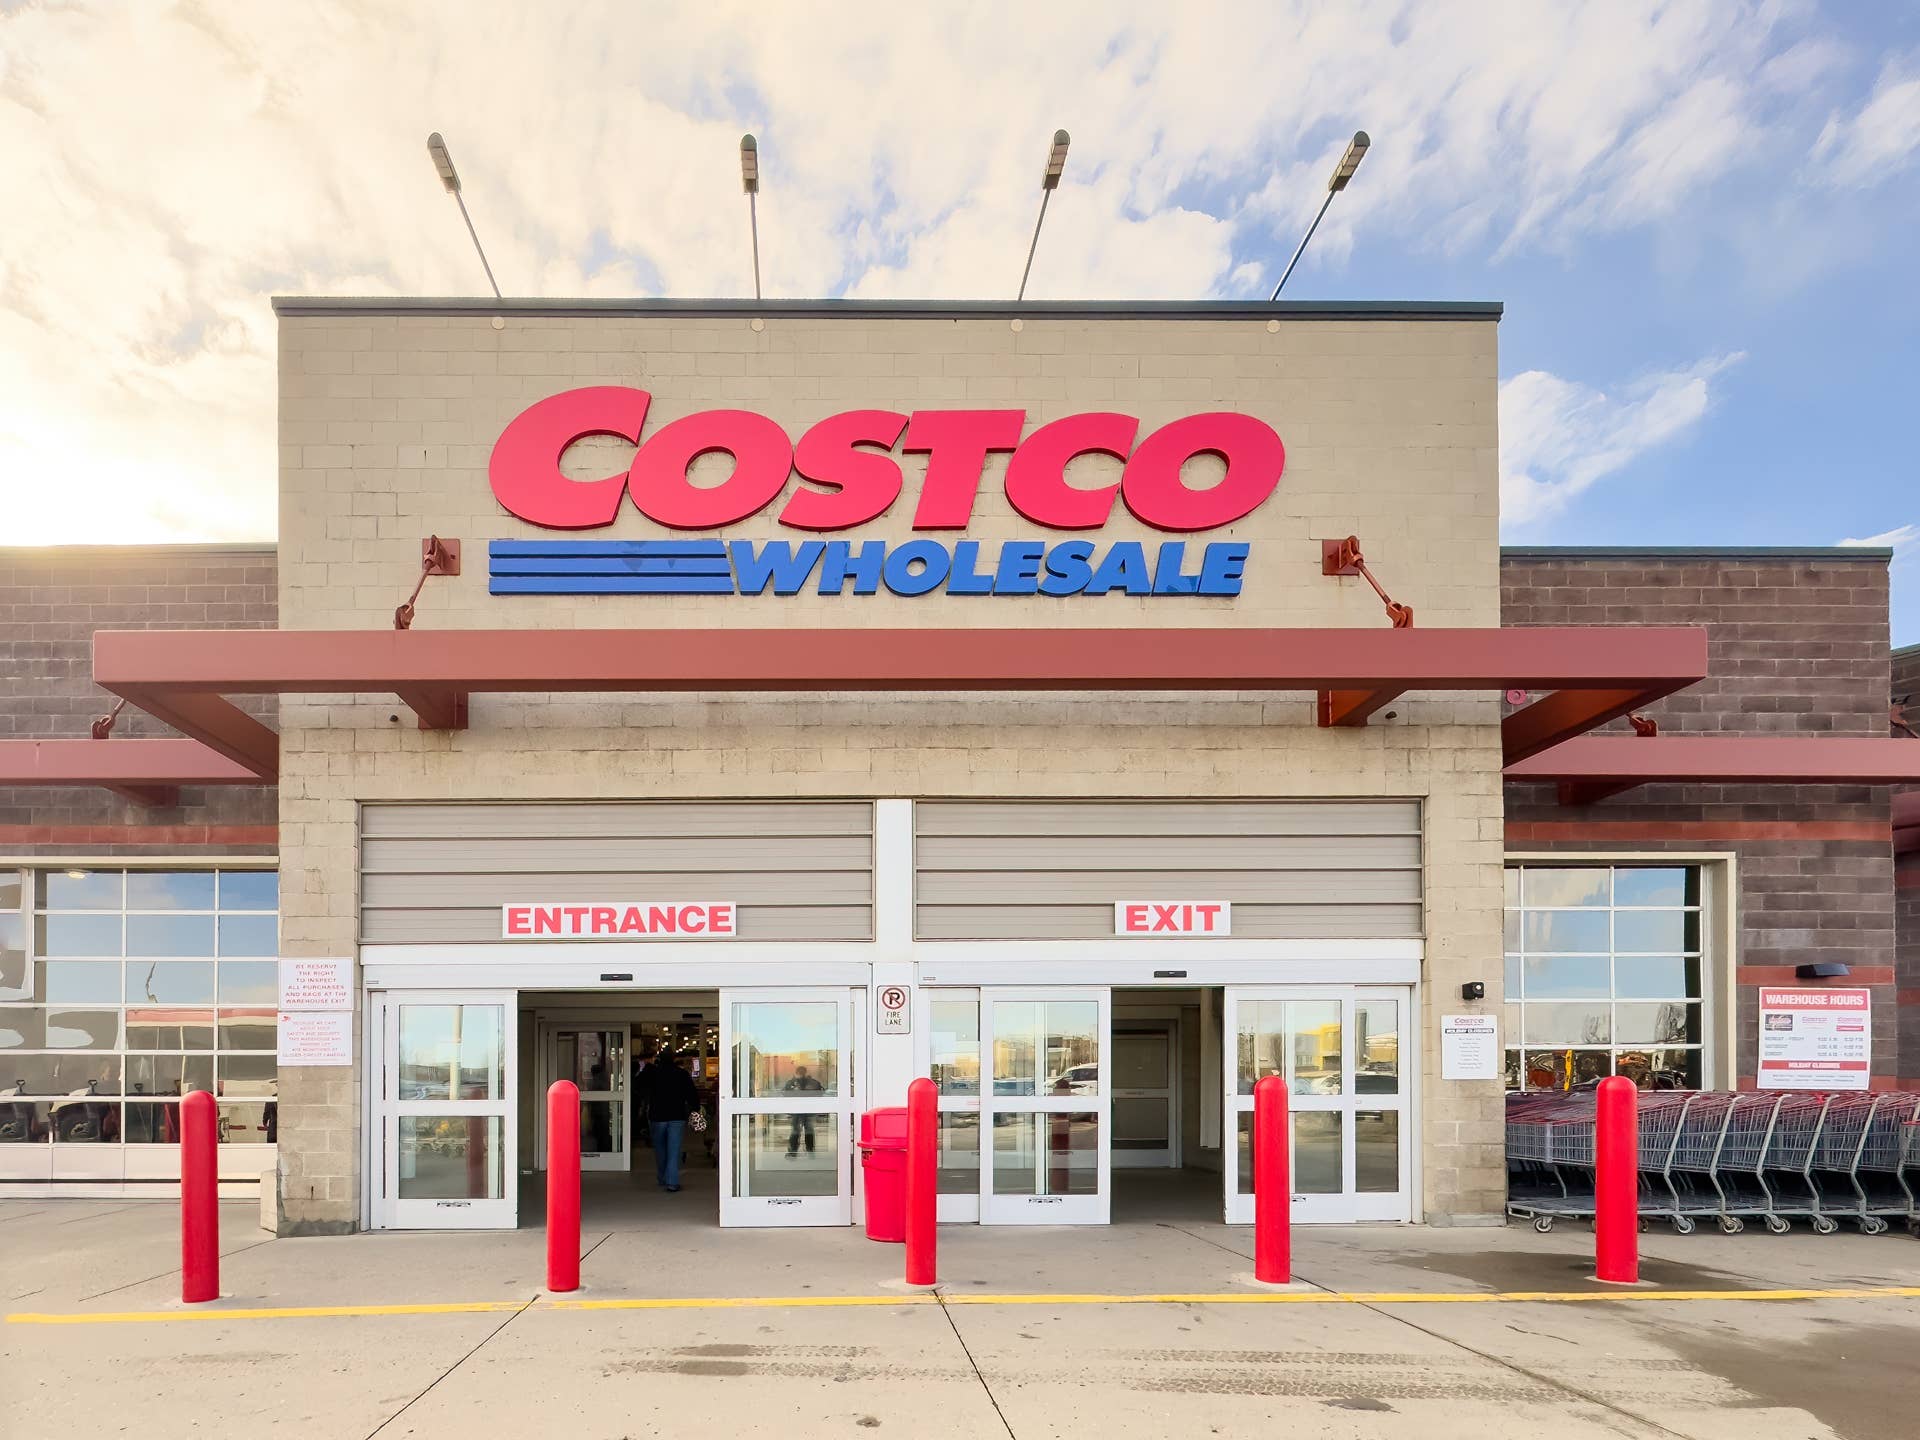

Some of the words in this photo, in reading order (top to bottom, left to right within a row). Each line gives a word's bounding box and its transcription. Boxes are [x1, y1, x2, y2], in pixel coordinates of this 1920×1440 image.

[488, 385, 1286, 533] COSTCO
[729, 540, 1250, 598] WHOLESALE
[507, 905, 732, 934] ENTRANCE
[1126, 904, 1221, 931] EXIT
[1765, 994, 1828, 1005] WAREHOUSE
[1829, 994, 1864, 1006] HOURS
